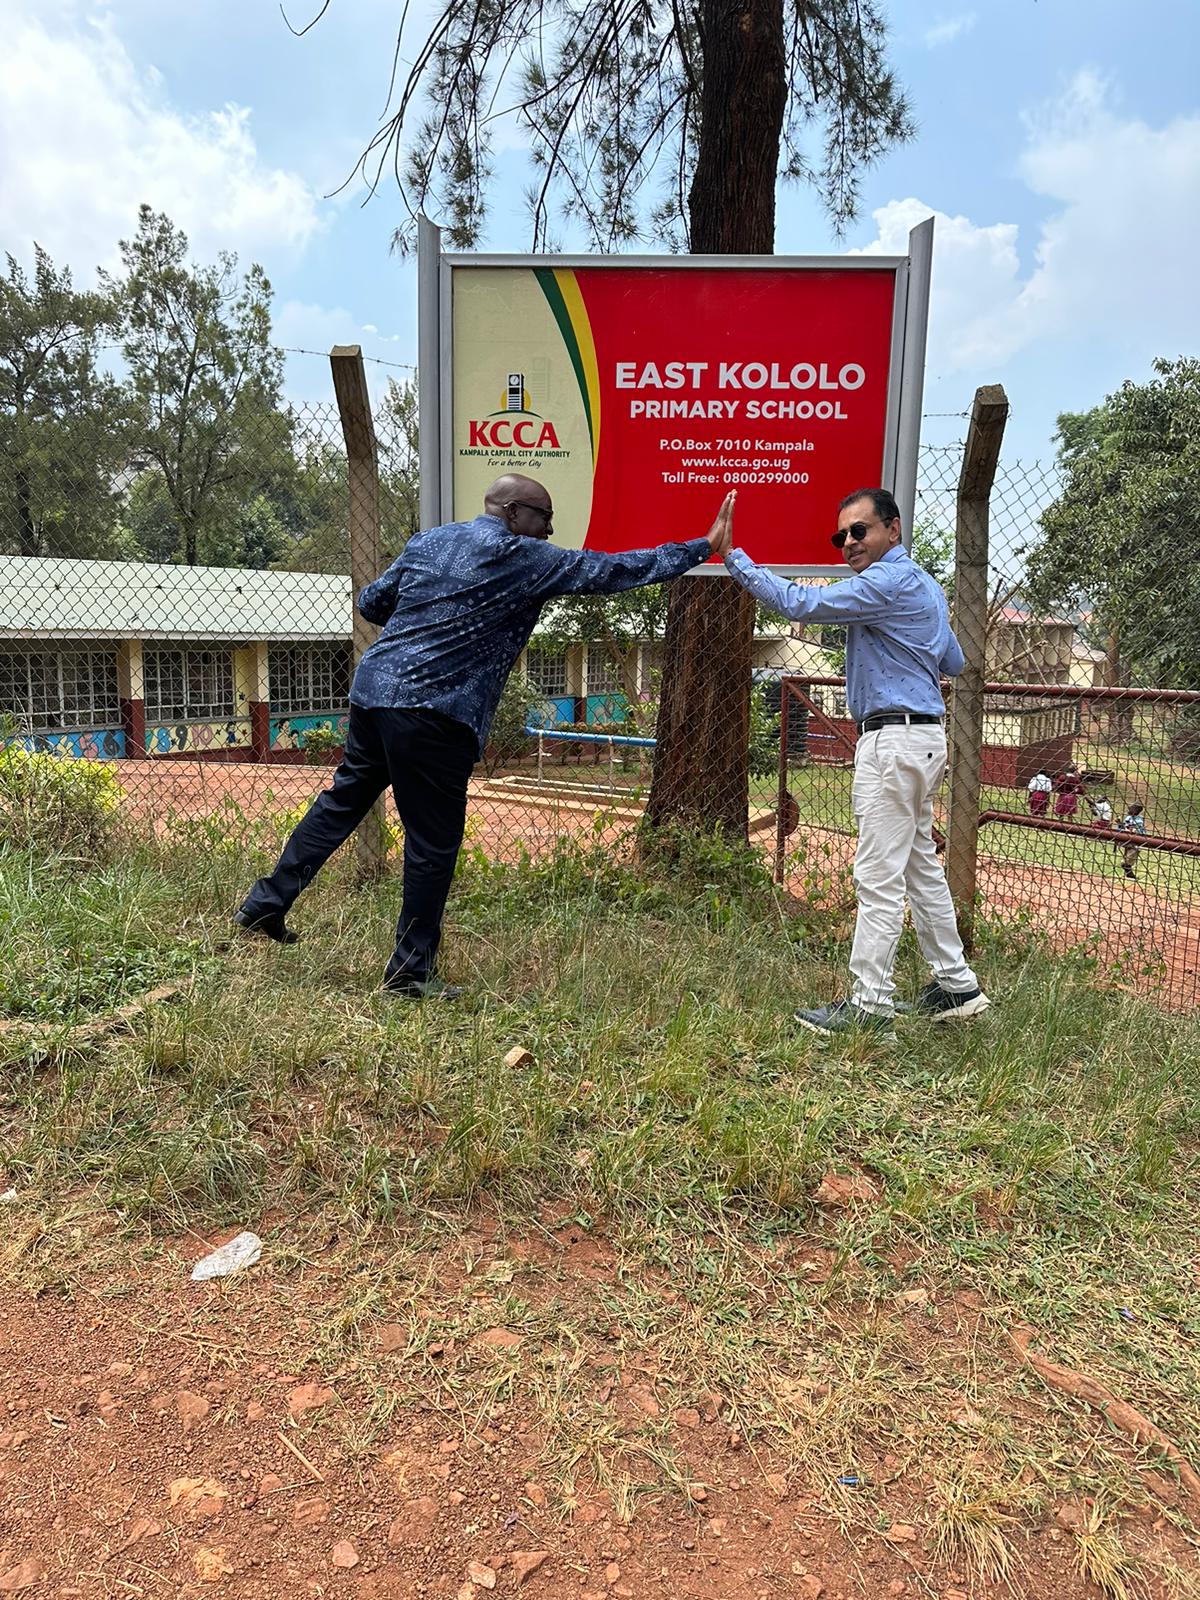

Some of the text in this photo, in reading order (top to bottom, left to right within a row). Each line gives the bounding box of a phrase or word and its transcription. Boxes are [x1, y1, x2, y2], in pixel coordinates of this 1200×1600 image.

[615, 362, 866, 391] EAST KOLOLO
[630, 400, 848, 419] PRIMARY SCHOOL
[468, 420, 561, 448] KCCA
[659, 439, 815, 453] P.O.Box 7010 Kampala
[460, 449, 489, 457] KAMPALA
[534, 450, 571, 458] AUTHORITY
[487, 458, 499, 466] For
[528, 459, 542, 468] City
[681, 456, 791, 470] www.kcca.go.ug
[662, 472, 809, 484] Toll Free: 0800299000
